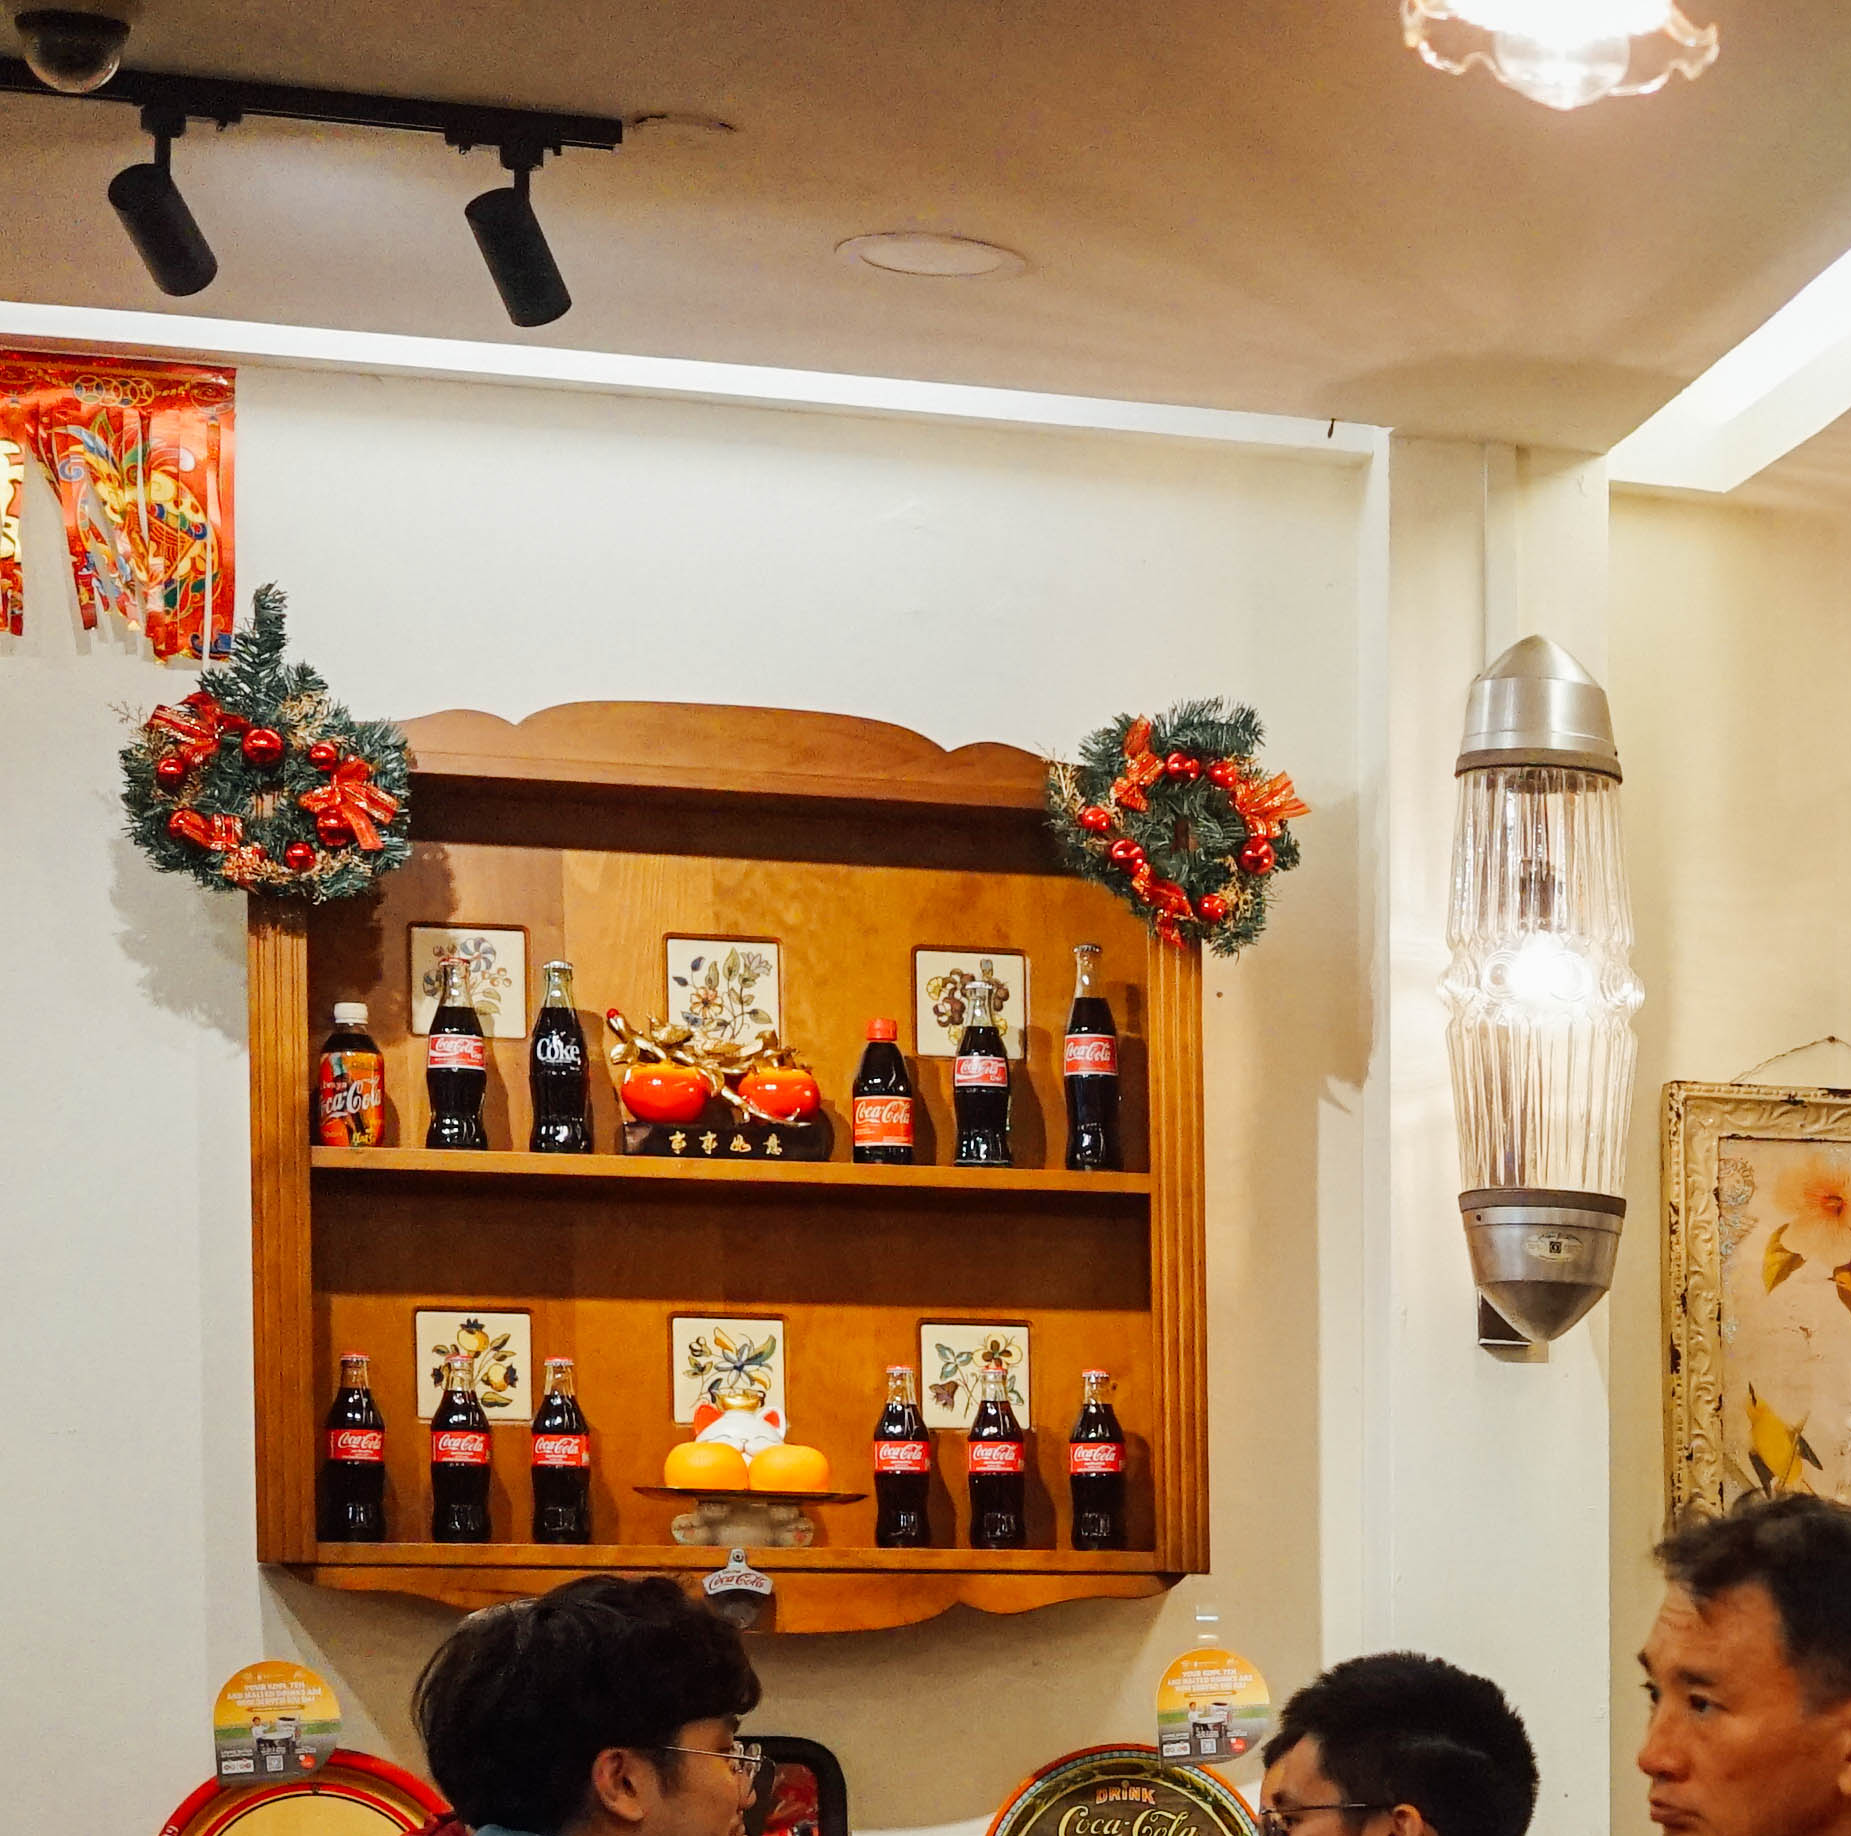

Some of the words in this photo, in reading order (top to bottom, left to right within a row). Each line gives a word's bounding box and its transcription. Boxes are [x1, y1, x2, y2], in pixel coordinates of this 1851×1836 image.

[535, 1036, 580, 1063] Coke
[855, 1100, 911, 1125] Coca-Cola
[668, 1130, 784, 1155] 事事如意
[338, 1431, 382, 1450] Coca-Cola
[438, 1432, 484, 1451] Coca-Cola
[534, 1436, 580, 1455] Coca-Cola
[879, 1443, 924, 1460] Coca-Cola
[972, 1443, 1017, 1461] Coca-Cola
[1074, 1445, 1117, 1462] Coca-Cola
[709, 1572, 767, 1590] Coca-Cola
[1095, 1785, 1156, 1806] DRINK
